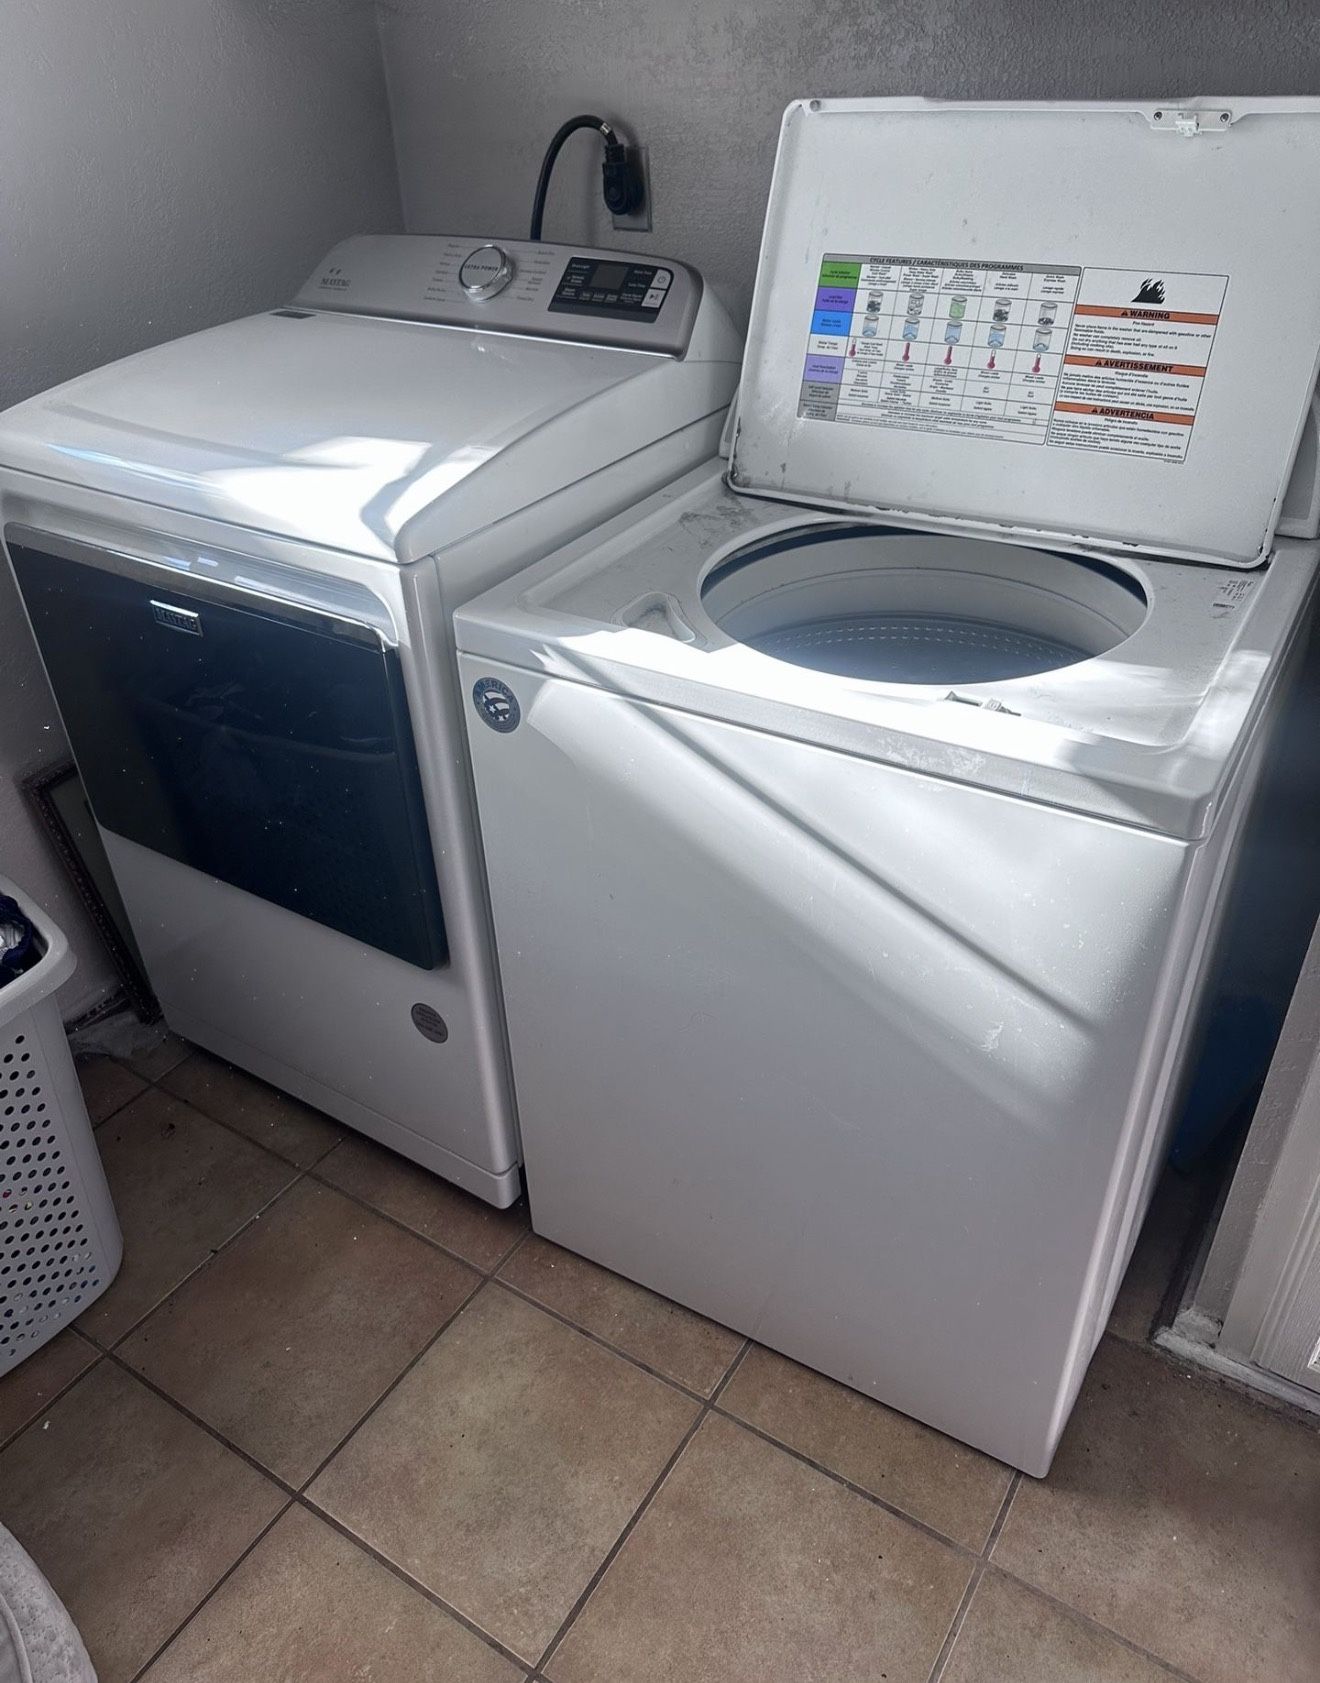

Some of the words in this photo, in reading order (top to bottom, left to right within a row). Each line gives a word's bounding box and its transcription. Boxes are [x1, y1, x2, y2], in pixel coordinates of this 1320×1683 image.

[1130, 310, 1170, 320] WARNING
[1104, 360, 1173, 373] AVERTISSEMENT
[1098, 408, 1154, 420] ADVERTENCIA
